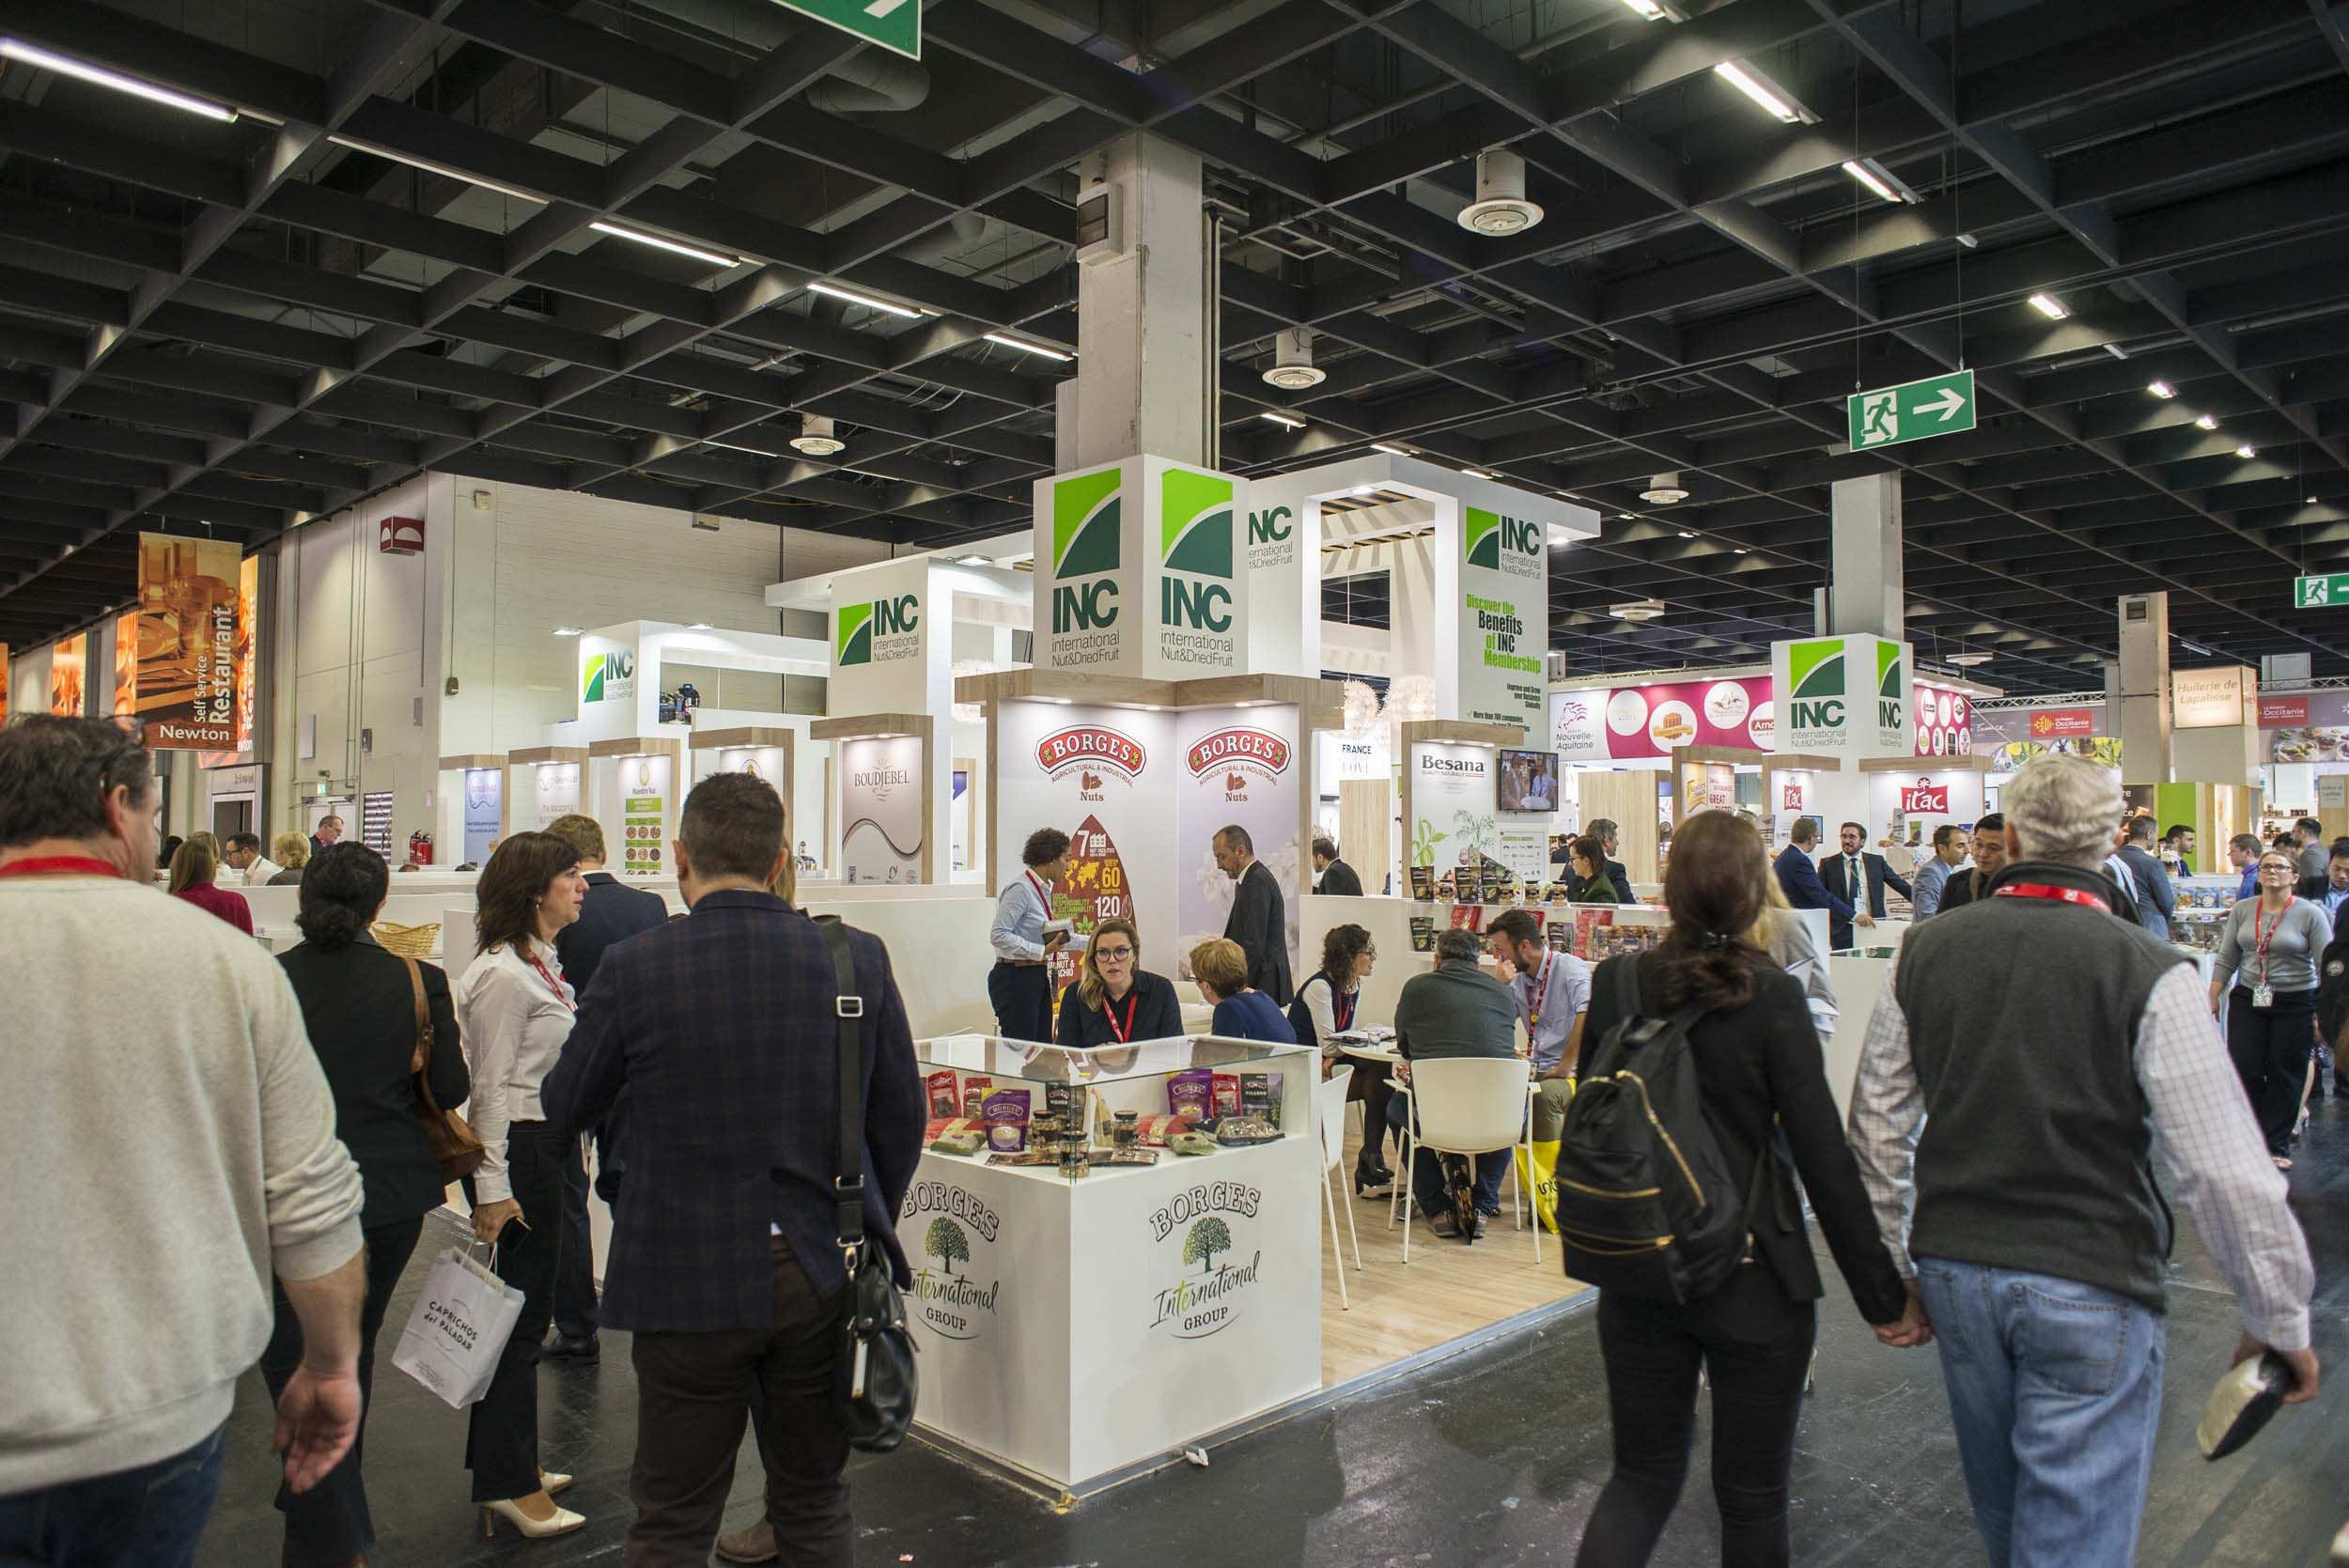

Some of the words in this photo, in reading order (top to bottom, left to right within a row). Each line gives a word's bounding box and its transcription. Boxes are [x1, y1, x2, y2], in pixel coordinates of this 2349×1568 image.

[1249, 506, 1292, 545] NC
[1501, 516, 1540, 556] INC
[1249, 541, 1293, 559] ernational
[1501, 552, 1541, 569] international
[1249, 553, 1293, 569] t&DriedFruit
[1053, 579, 1119, 634] INC
[1161, 576, 1232, 632] INC
[1467, 594, 1501, 613] Discover
[1502, 601, 1515, 615] the
[874, 595, 918, 636] INC
[1479, 611, 1522, 635] Benefits
[874, 633, 919, 650] international
[1052, 629, 1120, 652] international
[1161, 629, 1233, 652] international
[1486, 633, 1497, 649] of
[1498, 633, 1515, 653] INC
[874, 647, 919, 661] Nut&DriedFruit
[1052, 648, 1119, 667] Nut&DriedFruit
[1161, 646, 1233, 667] Nut&DriedFruit
[1484, 649, 1541, 675] Membership
[209, 606, 232, 724] Restaurant
[606, 650, 632, 680] INC
[194, 656, 207, 697] Service
[2177, 680, 2220, 692] Huilerie
[2224, 679, 2237, 690] de
[2180, 693, 2232, 705] Lapalisse
[194, 700, 206, 722] Self
[1791, 700, 1844, 729] INC
[1879, 700, 1901, 729] INC
[160, 725, 229, 741] Newton
[1556, 732, 1594, 741] Nouvelle-
[1791, 729, 1846, 739] international
[1051, 733, 1131, 761] BORGES
[1199, 735, 1275, 764] BORGES
[1342, 744, 1372, 754] FRANCE
[1556, 741, 1594, 752] Aquitaine
[1422, 754, 1485, 772] Besana
[854, 769, 910, 788] BOUDJEBEL
[1050, 763, 1095, 784] AGRICULTURAL
[1102, 765, 1134, 788] INDUSTRIAL
[1199, 765, 1239, 786] AGRICULTURAL
[1246, 765, 1277, 786] INDUSTRIAL
[1080, 791, 1104, 801] Nuts
[1225, 792, 1249, 802] Nuts
[1709, 795, 1725, 804] GREAT
[1785, 788, 1801, 806] itac
[1906, 791, 1945, 811] itac
[1077, 831, 1090, 857] 7
[1102, 867, 1121, 888] 60
[1095, 896, 1120, 917] 120
[1070, 959, 1074, 968] &
[903, 1181, 1000, 1243] BORGES
[1150, 1181, 1261, 1242] BORGES
[1150, 1250, 1261, 1328] International
[428, 1301, 478, 1341] CAPRICHOS
[926, 1307, 967, 1330] GROUP
[1184, 1307, 1228, 1330] GROUP
[424, 1312, 437, 1324] del
[440, 1320, 473, 1352] PALADAR
